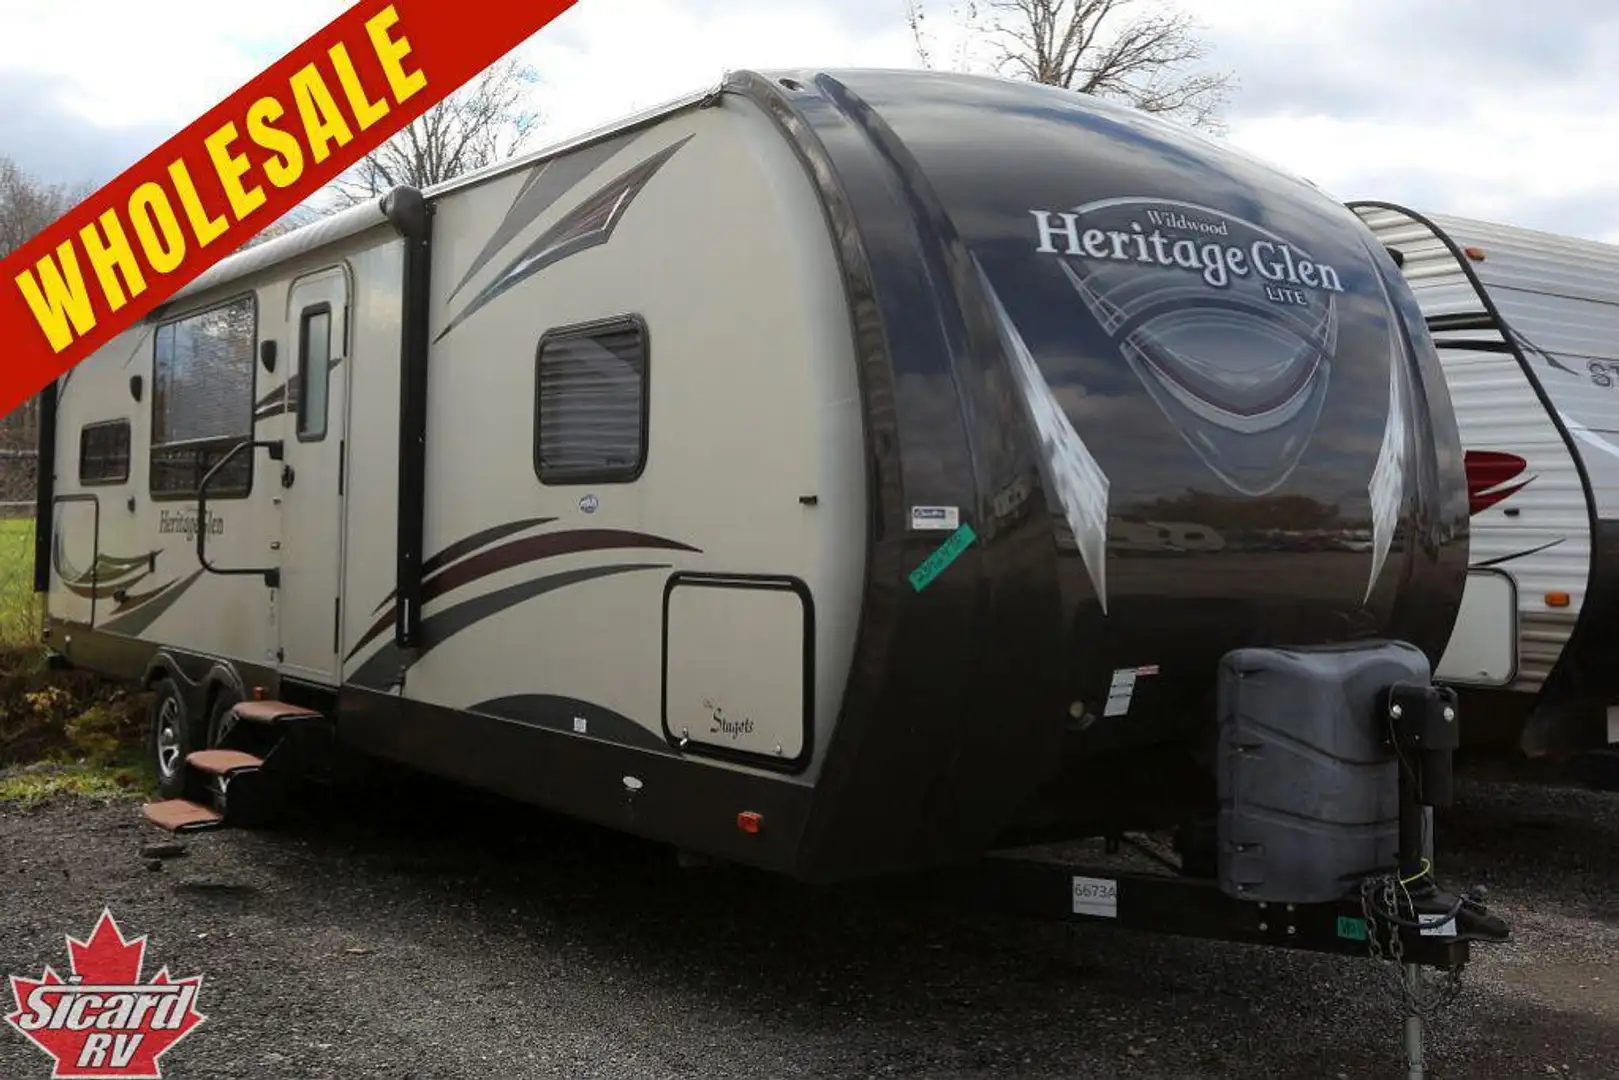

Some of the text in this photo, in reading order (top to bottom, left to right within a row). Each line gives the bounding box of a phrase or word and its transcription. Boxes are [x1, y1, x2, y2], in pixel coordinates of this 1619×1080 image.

[1147, 209, 1229, 237] Wildwood
[1029, 210, 1345, 293] Heritage Glen
[1266, 286, 1307, 306] LITE
